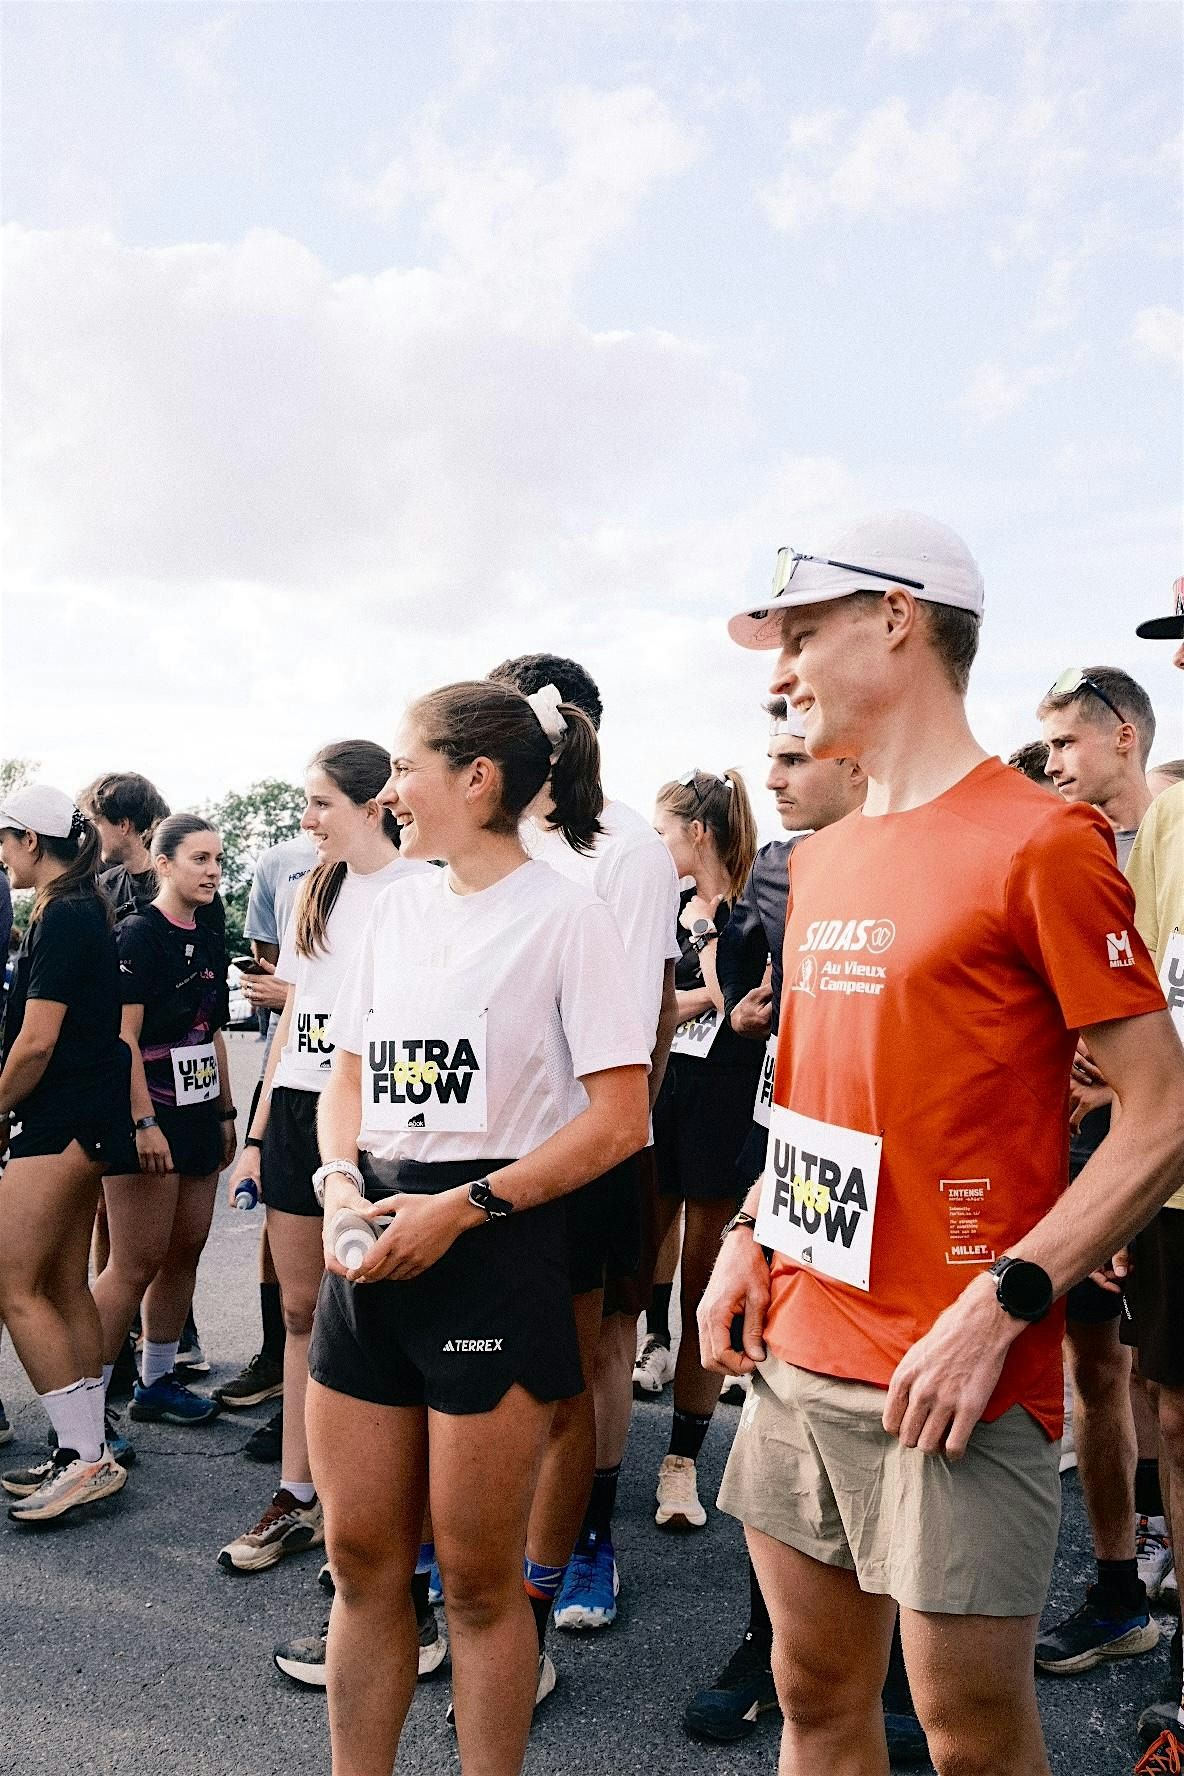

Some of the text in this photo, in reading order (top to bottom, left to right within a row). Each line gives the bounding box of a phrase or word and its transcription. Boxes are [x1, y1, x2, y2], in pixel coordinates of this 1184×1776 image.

[798, 920, 876, 951] SIDAS
[821, 961, 887, 978] Au Vieux
[820, 977, 884, 996] Campeur
[298, 1013, 332, 1033] ULT
[178, 1055, 217, 1076] ULTR
[369, 1039, 480, 1072] ULTRA
[373, 1072, 473, 1105] FLOW
[773, 1138, 868, 1212] ULTRA
[948, 1188, 984, 1197] INTENSE
[772, 1179, 861, 1249] FLOW
[455, 1339, 503, 1352] TERREX
